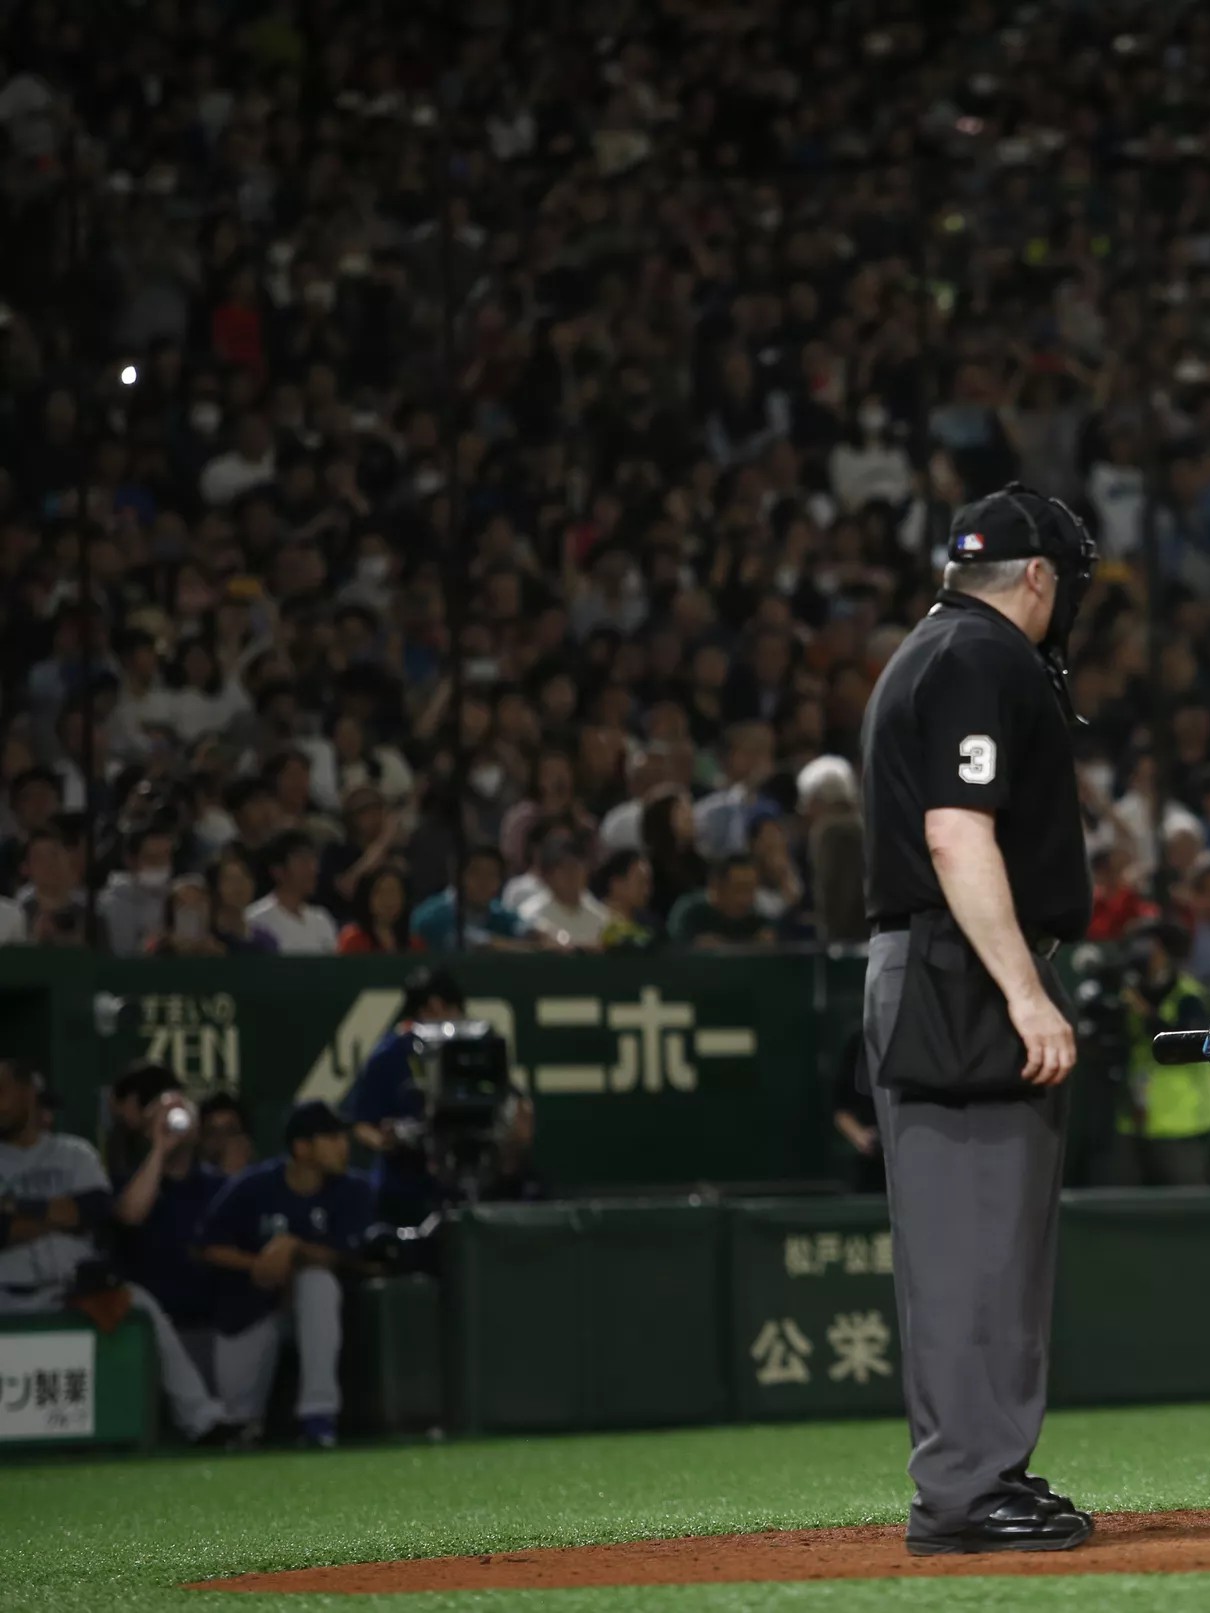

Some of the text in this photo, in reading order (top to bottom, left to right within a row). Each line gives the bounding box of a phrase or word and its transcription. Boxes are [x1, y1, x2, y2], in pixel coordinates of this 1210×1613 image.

[958, 734, 997, 785] 3
[0, 1367, 88, 1412] ン製薬
